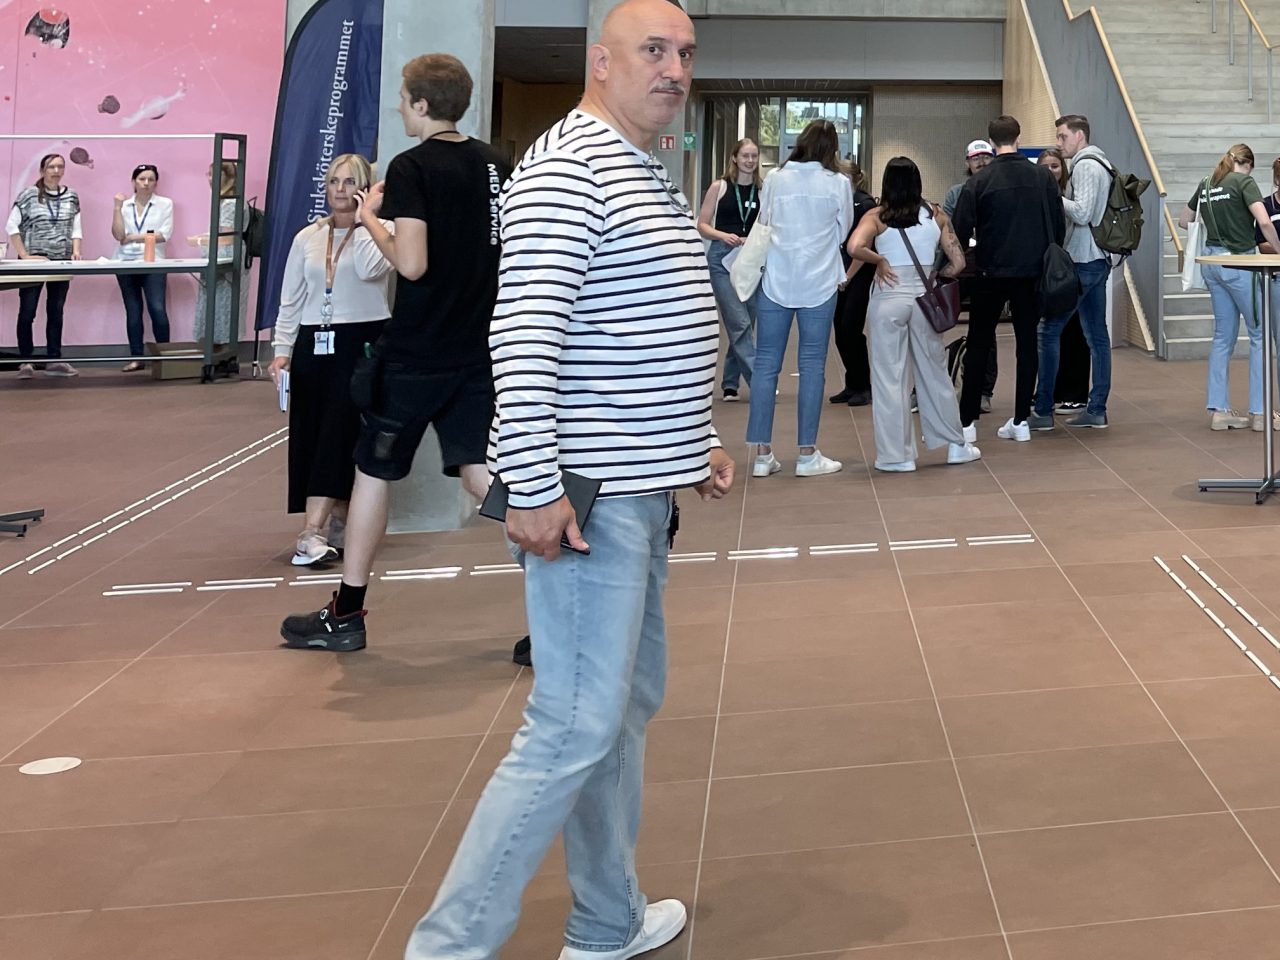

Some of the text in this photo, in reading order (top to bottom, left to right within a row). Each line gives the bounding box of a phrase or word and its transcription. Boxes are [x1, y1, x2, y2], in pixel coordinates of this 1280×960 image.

[307, 19, 355, 224] Sjuksköterskeprogrammet
[487, 163, 501, 246] MED Service
